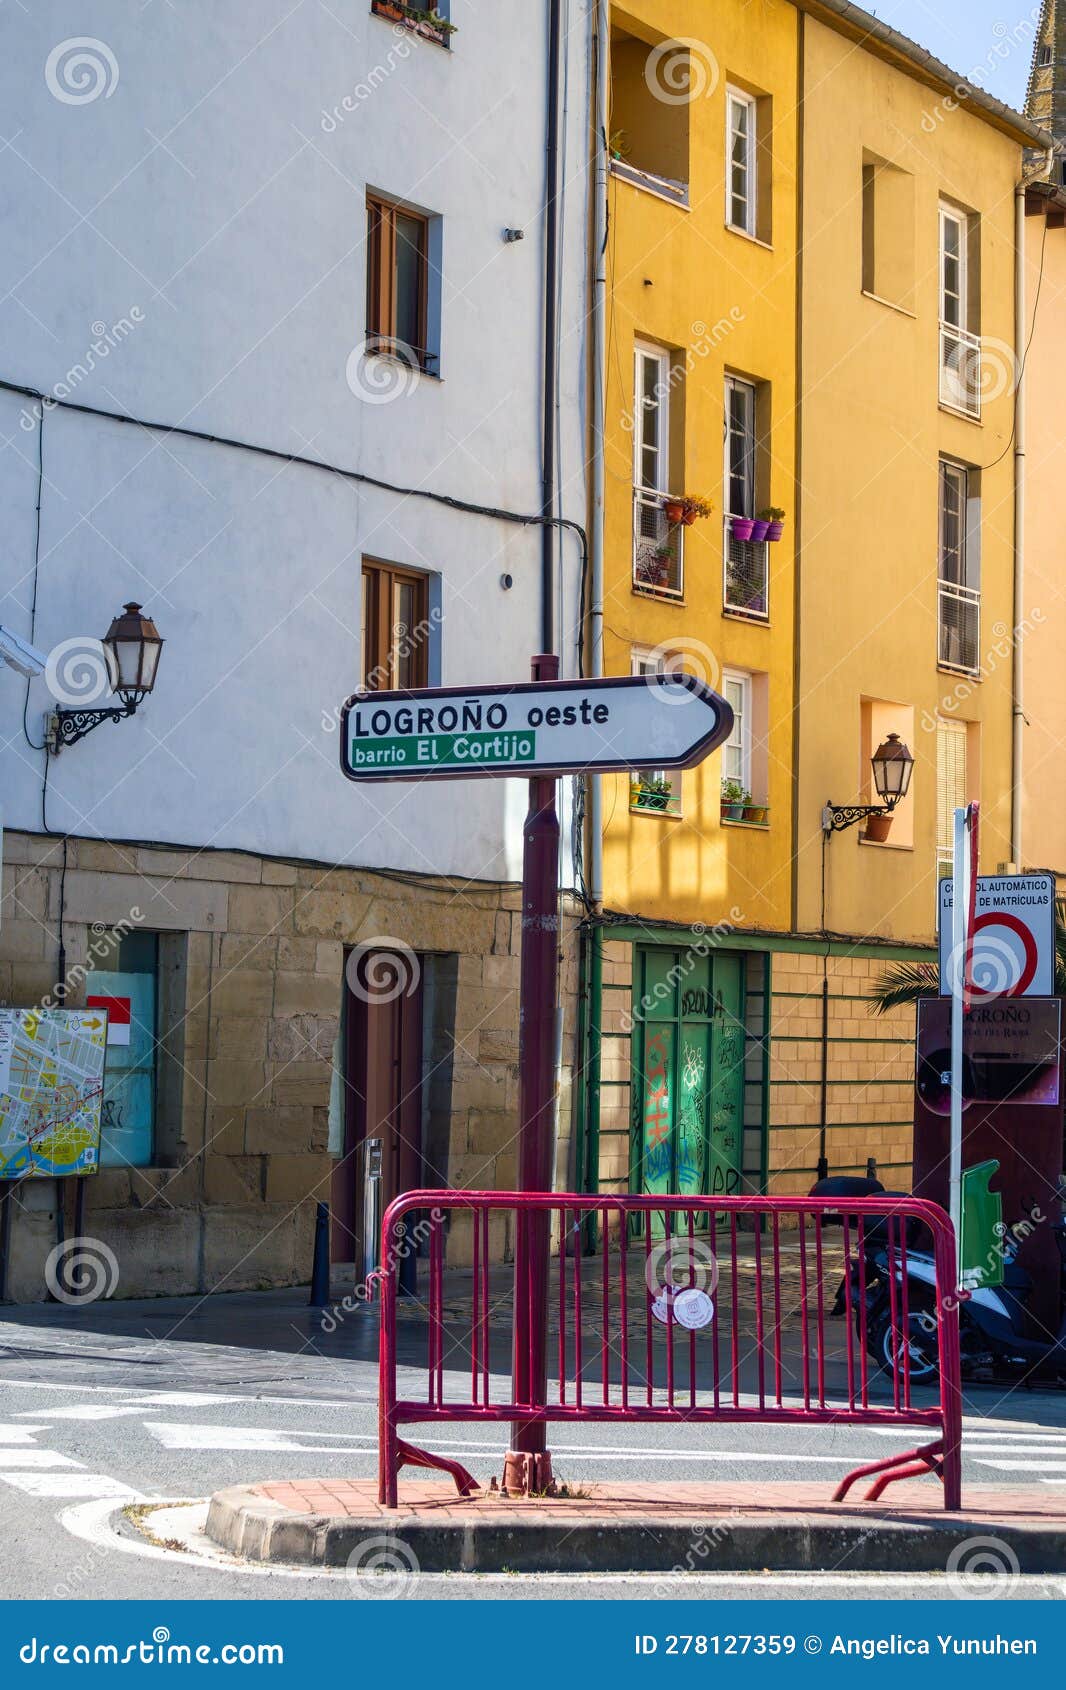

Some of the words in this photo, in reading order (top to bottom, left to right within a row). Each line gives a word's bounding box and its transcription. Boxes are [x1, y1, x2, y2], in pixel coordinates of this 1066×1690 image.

[355, 700, 508, 737] LOGROÑO
[527, 698, 610, 728] oeste
[355, 744, 406, 765] barrio
[416, 740, 439, 761] El
[453, 737, 532, 762] Cortijo
[989, 880, 1048, 892] AUTOMÁTICO
[980, 898, 990, 906] DE
[993, 894, 1049, 906] MATRÍCULAS
